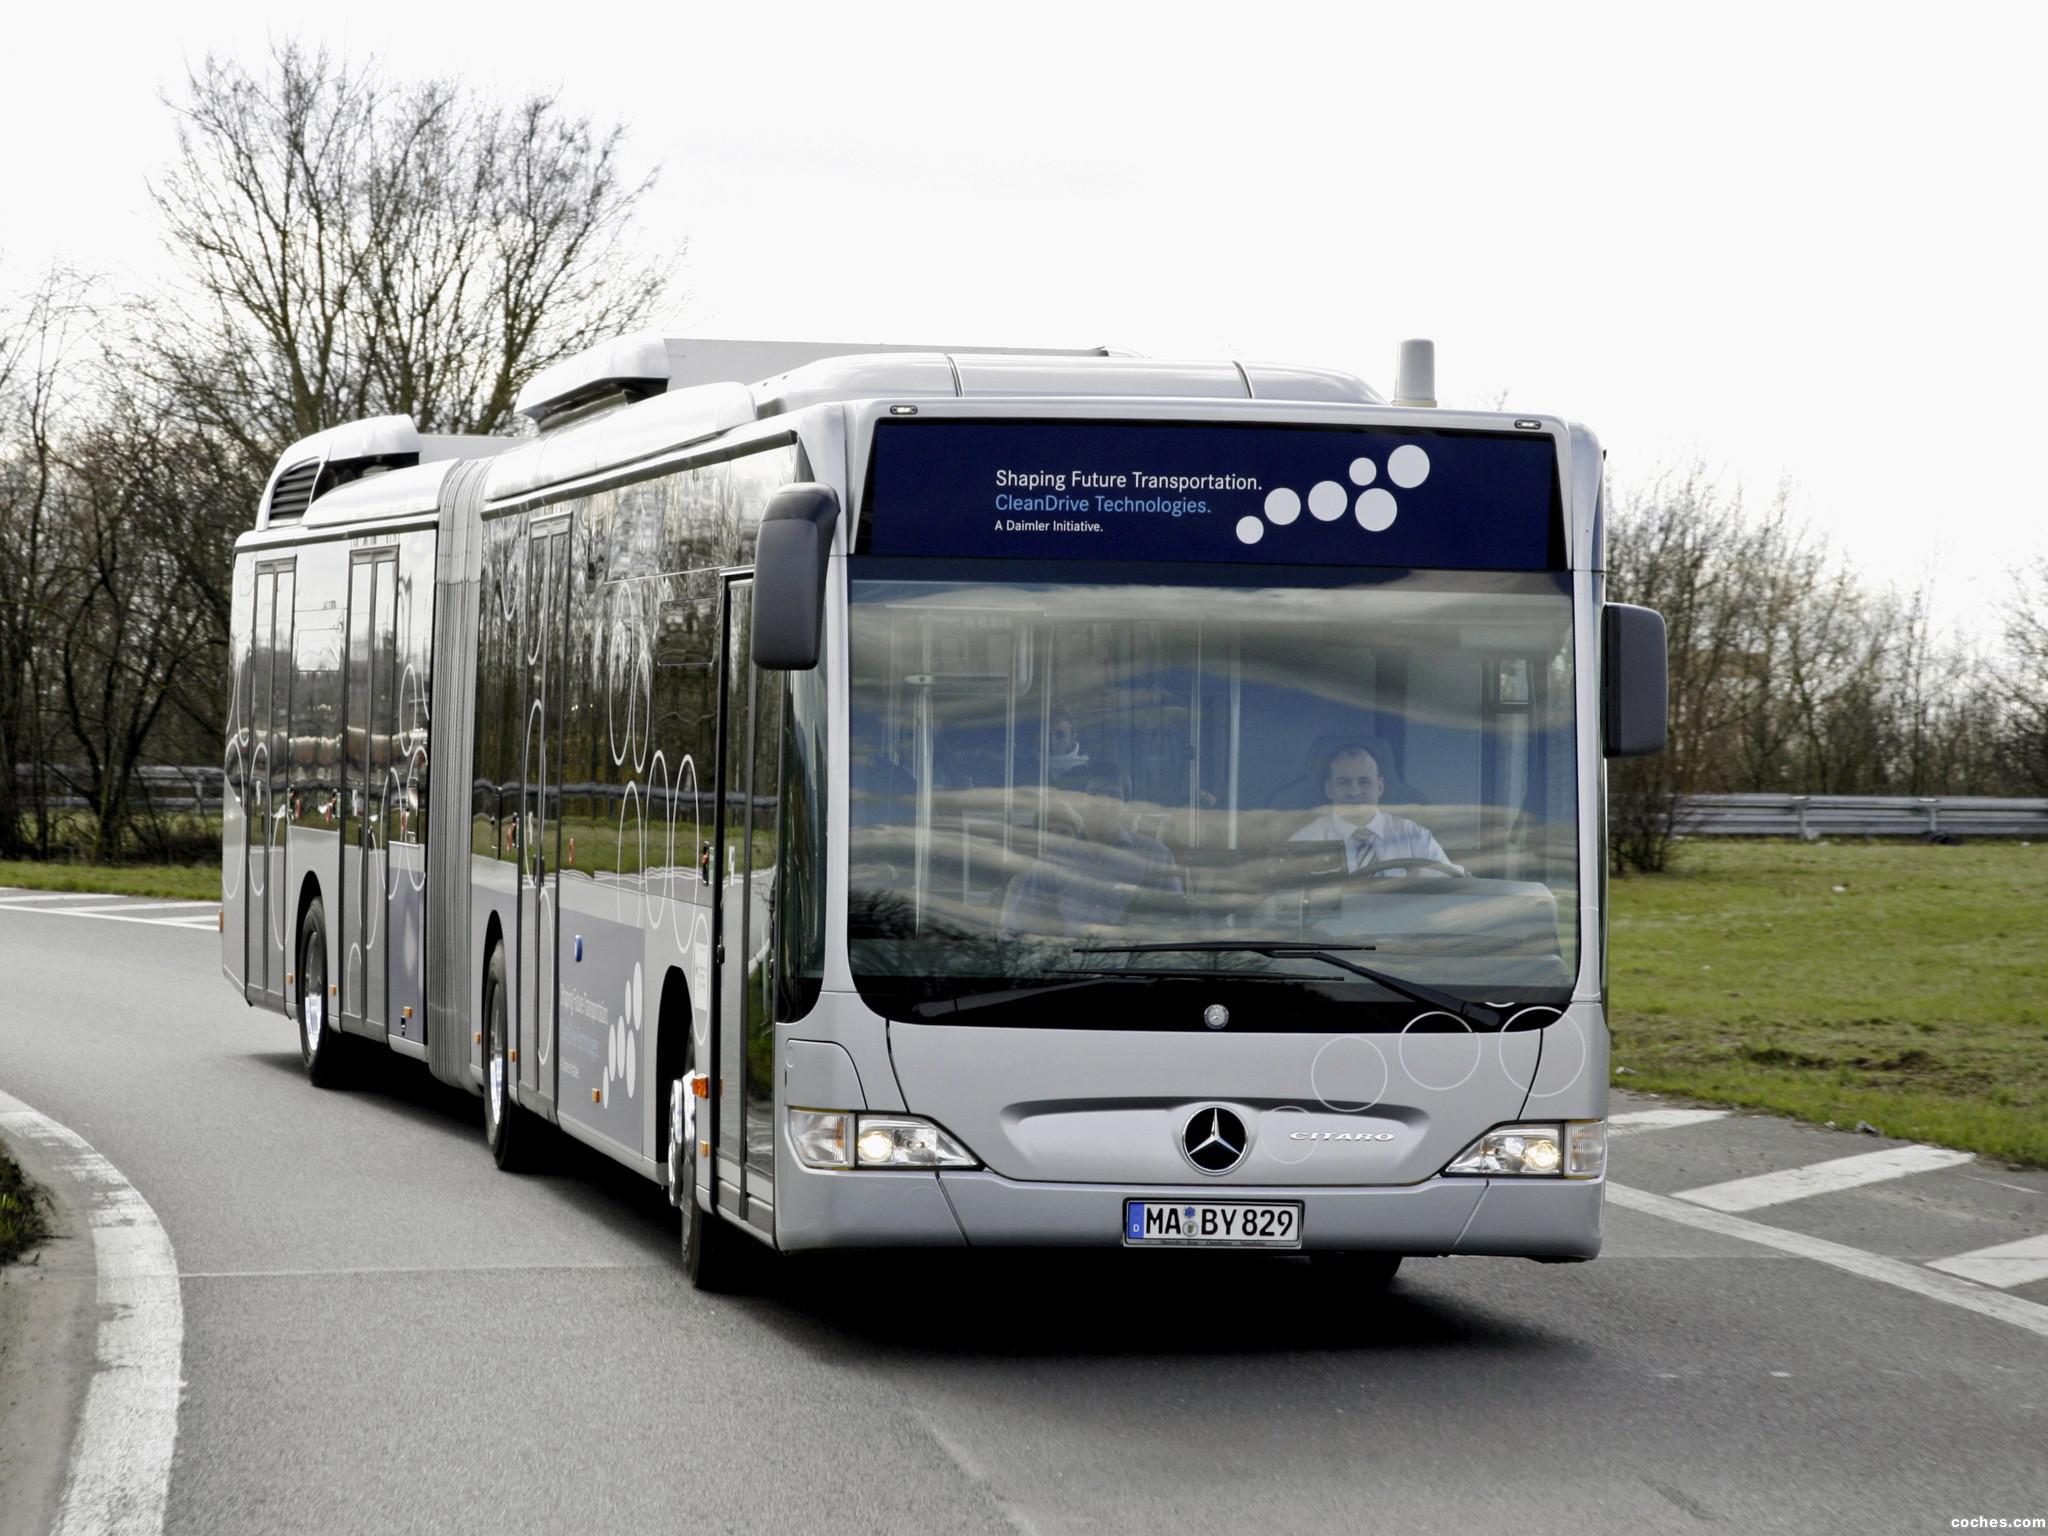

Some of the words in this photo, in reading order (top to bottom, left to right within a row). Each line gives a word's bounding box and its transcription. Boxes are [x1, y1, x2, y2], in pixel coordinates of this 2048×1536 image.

[995, 469, 1066, 491] Shaping
[1071, 470, 1127, 488] Future
[1132, 471, 1262, 493] Transportation.
[995, 494, 1090, 512] CleanDrive
[1094, 495, 1212, 517] Technologies.
[994, 519, 1004, 531] A
[1006, 519, 1050, 532] Daimler
[1053, 520, 1104, 532] Initiative.
[1289, 1131, 1396, 1142] CITARO
[1132, 1223, 1140, 1233] D
[1146, 1207, 1182, 1235] MA
[1200, 1208, 1238, 1236] BY
[1241, 1209, 1294, 1237] 829
